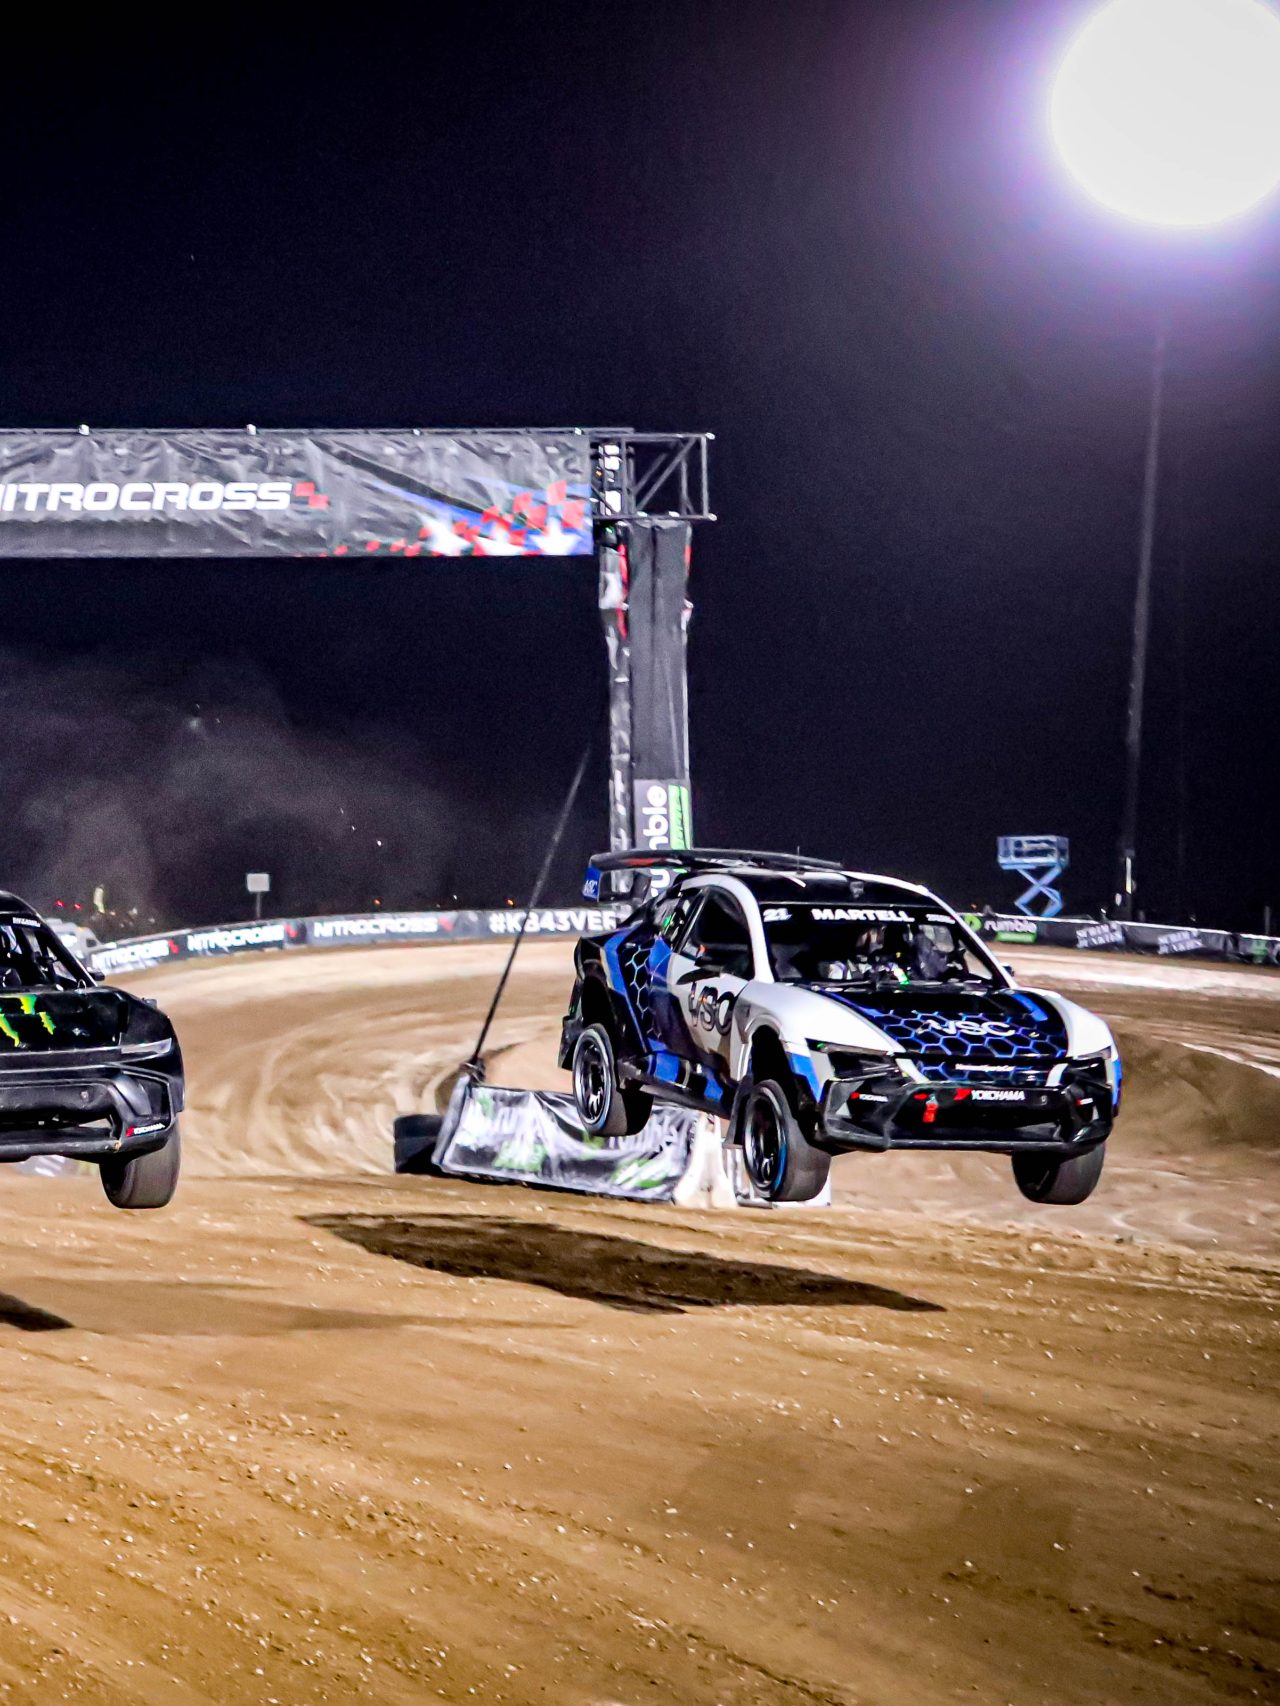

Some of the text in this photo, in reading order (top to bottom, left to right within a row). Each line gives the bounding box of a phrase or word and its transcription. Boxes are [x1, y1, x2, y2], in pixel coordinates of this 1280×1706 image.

[811, 909, 916, 923] MARTELL
[314, 916, 439, 938] NITROCROSS
[971, 1090, 1026, 1101] YOKOHAMA
